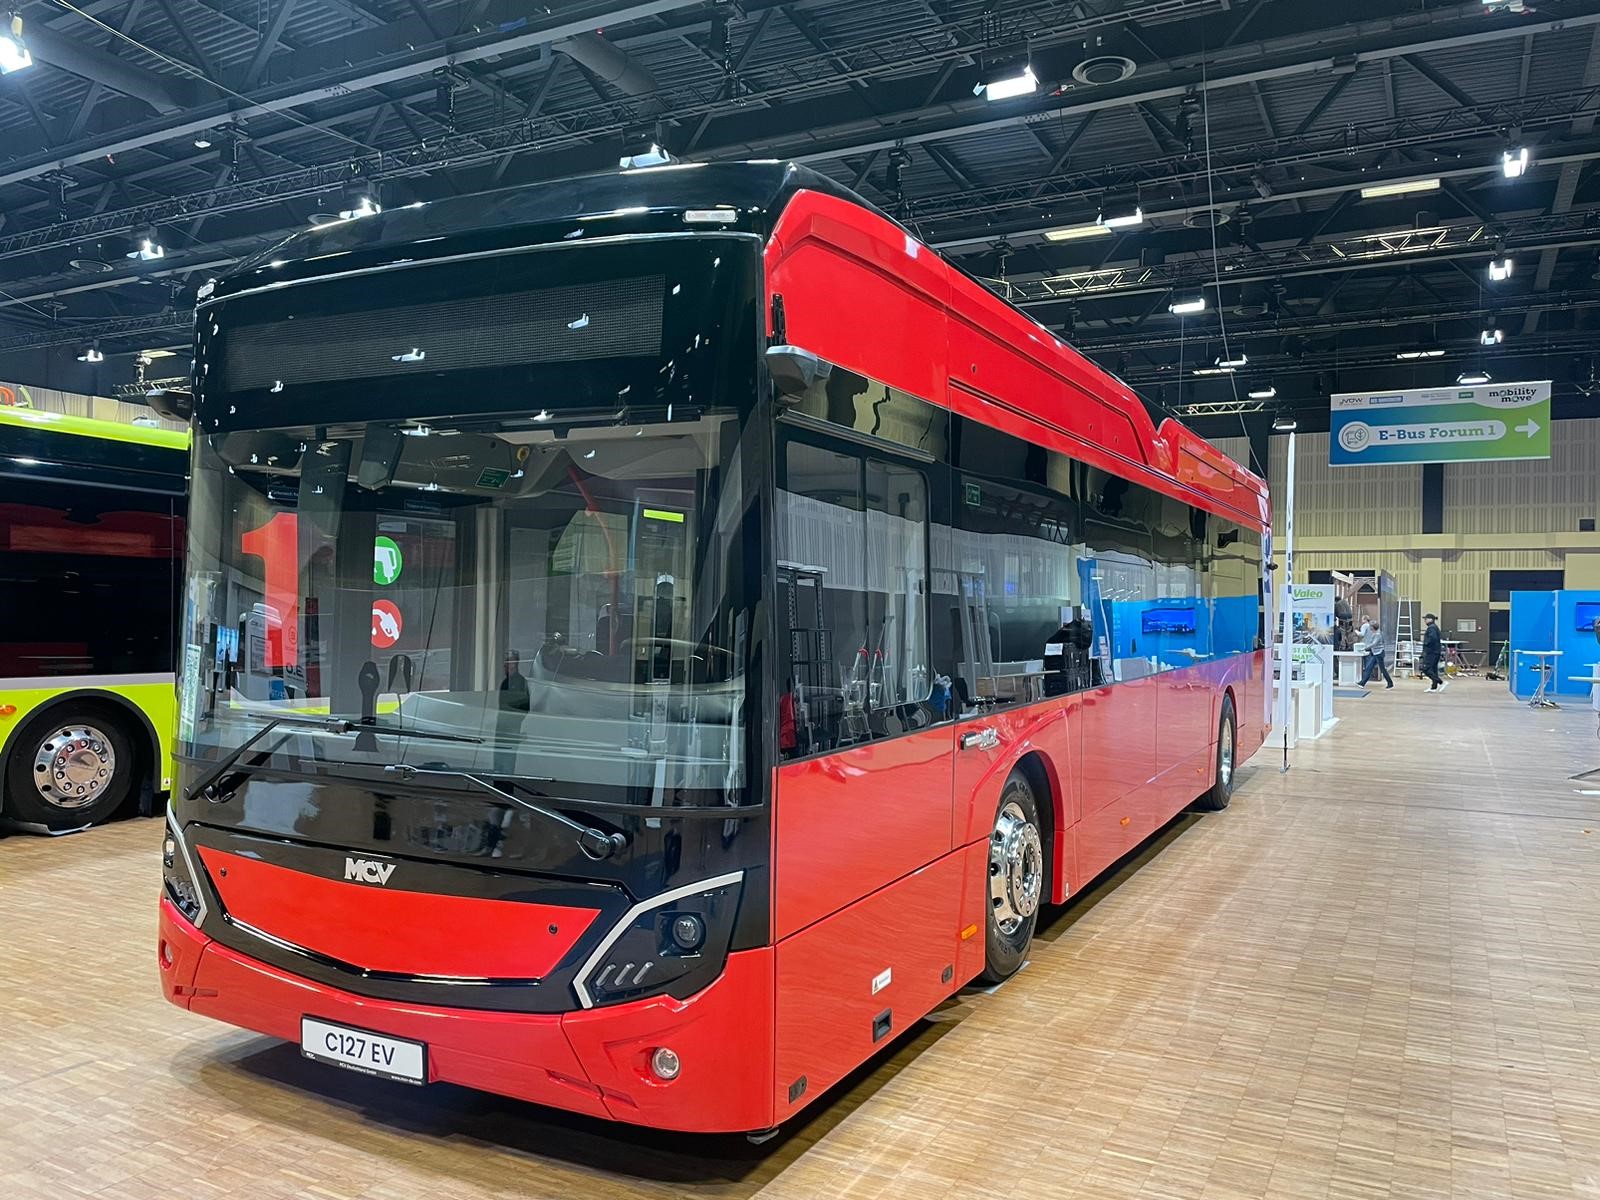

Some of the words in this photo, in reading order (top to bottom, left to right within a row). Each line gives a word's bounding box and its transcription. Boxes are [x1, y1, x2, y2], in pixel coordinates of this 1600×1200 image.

[1489, 387, 1537, 398] mobility
[1501, 394, 1532, 402] move
[1379, 429, 1426, 441] E-Bus
[1429, 426, 1484, 439] Forum
[1488, 425, 1496, 436] 1
[1293, 588, 1323, 598] Valeo
[344, 857, 397, 885] MCV
[325, 1032, 366, 1059] C127
[372, 1043, 395, 1066] EV
